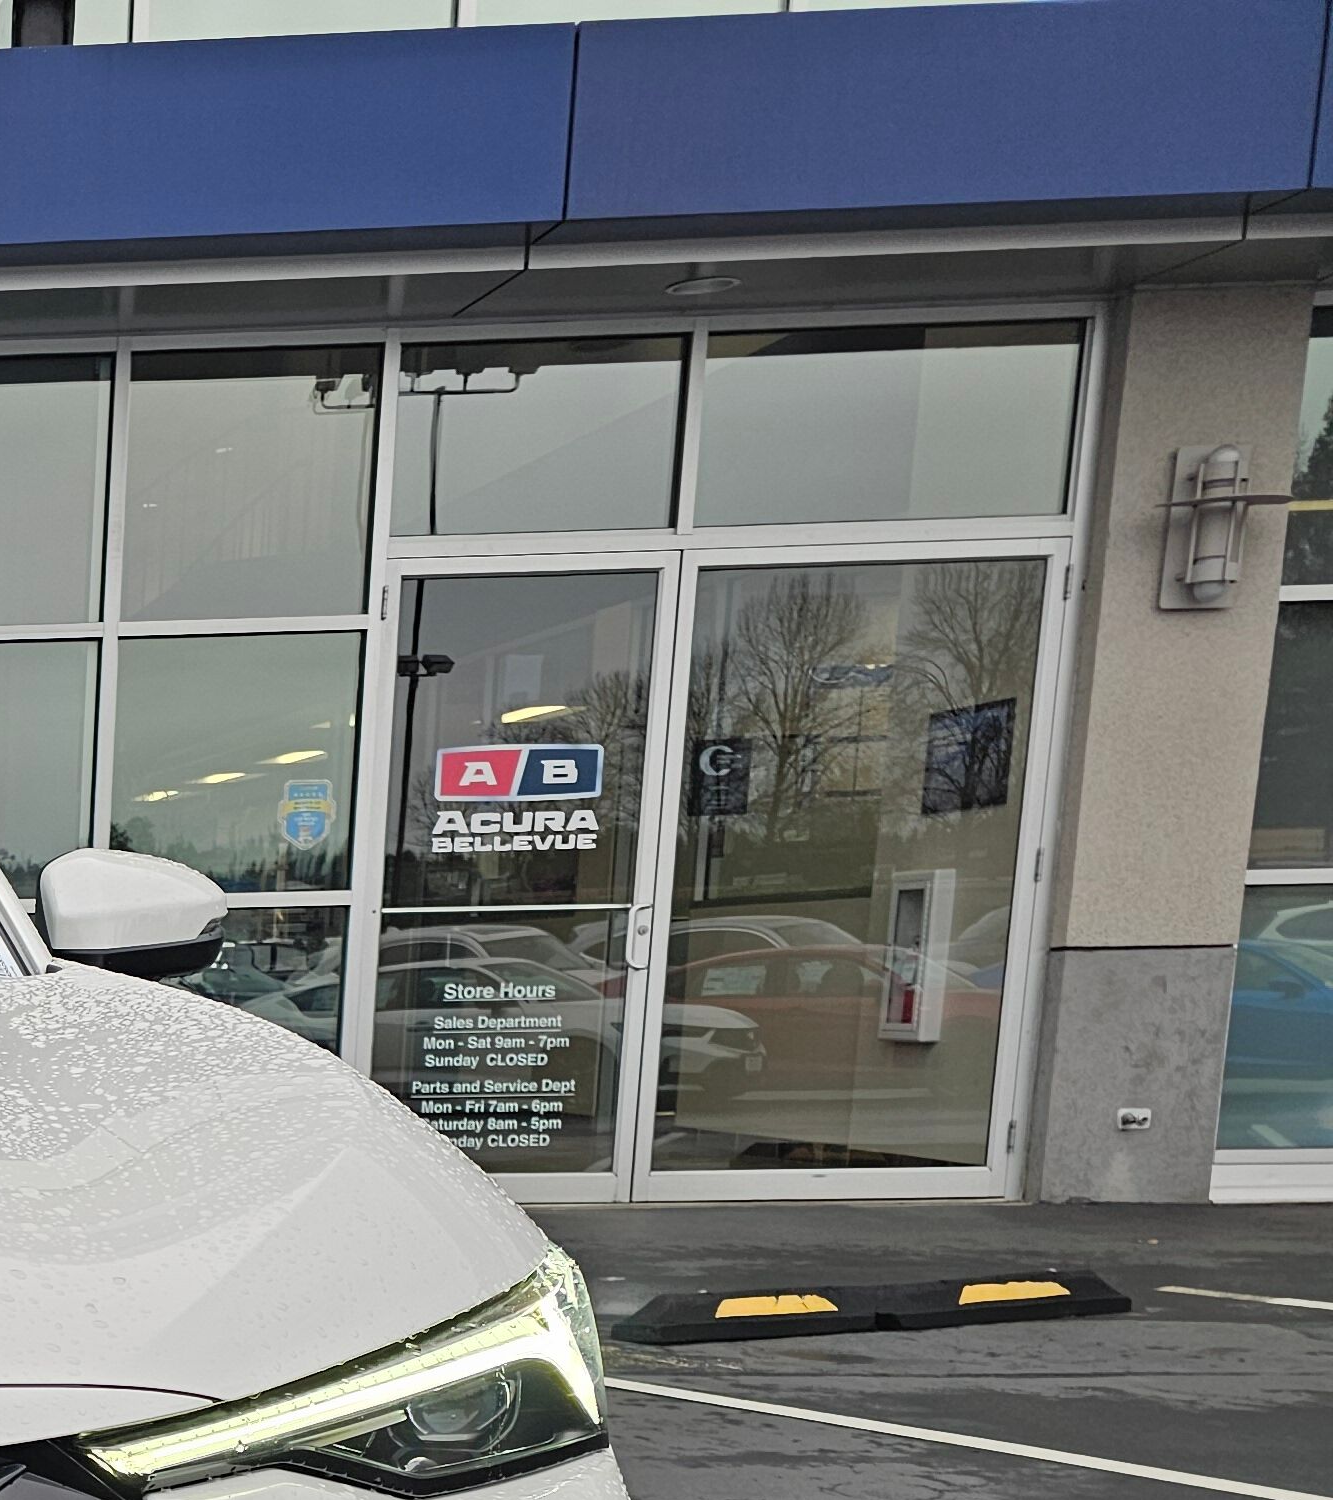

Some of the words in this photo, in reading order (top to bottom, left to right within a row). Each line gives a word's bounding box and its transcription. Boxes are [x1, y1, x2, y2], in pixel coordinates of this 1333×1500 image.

[458, 761, 498, 787] A
[540, 759, 579, 784] B
[431, 809, 600, 835] ACURA
[431, 833, 598, 853] BELLEVUE
[443, 983, 496, 1000] Store
[499, 982, 556, 999] Hours
[434, 1016, 474, 1030] Sales
[477, 1014, 563, 1031] Department
[423, 1036, 455, 1050] Mon
[467, 1036, 492, 1049] Sat
[494, 1035, 525, 1049] 9am
[538, 1035, 570, 1051] 7pm
[425, 1054, 480, 1070] Sunday
[486, 1053, 549, 1067] CLOSED
[412, 1081, 450, 1094] Parts
[452, 1081, 480, 1093] and
[483, 1079, 538, 1093] Service
[541, 1078, 576, 1095] Dept
[421, 1100, 453, 1114] Mon
[465, 1100, 484, 1113] Fri
[488, 1101, 519, 1113] 7am
[531, 1100, 563, 1116] 6pm
[424, 1117, 484, 1133] aturday
[487, 1117, 518, 1130] 8am
[530, 1117, 562, 1132] 5pm
[449, 1135, 483, 1150] nday
[487, 1134, 550, 1147] CLOSED
